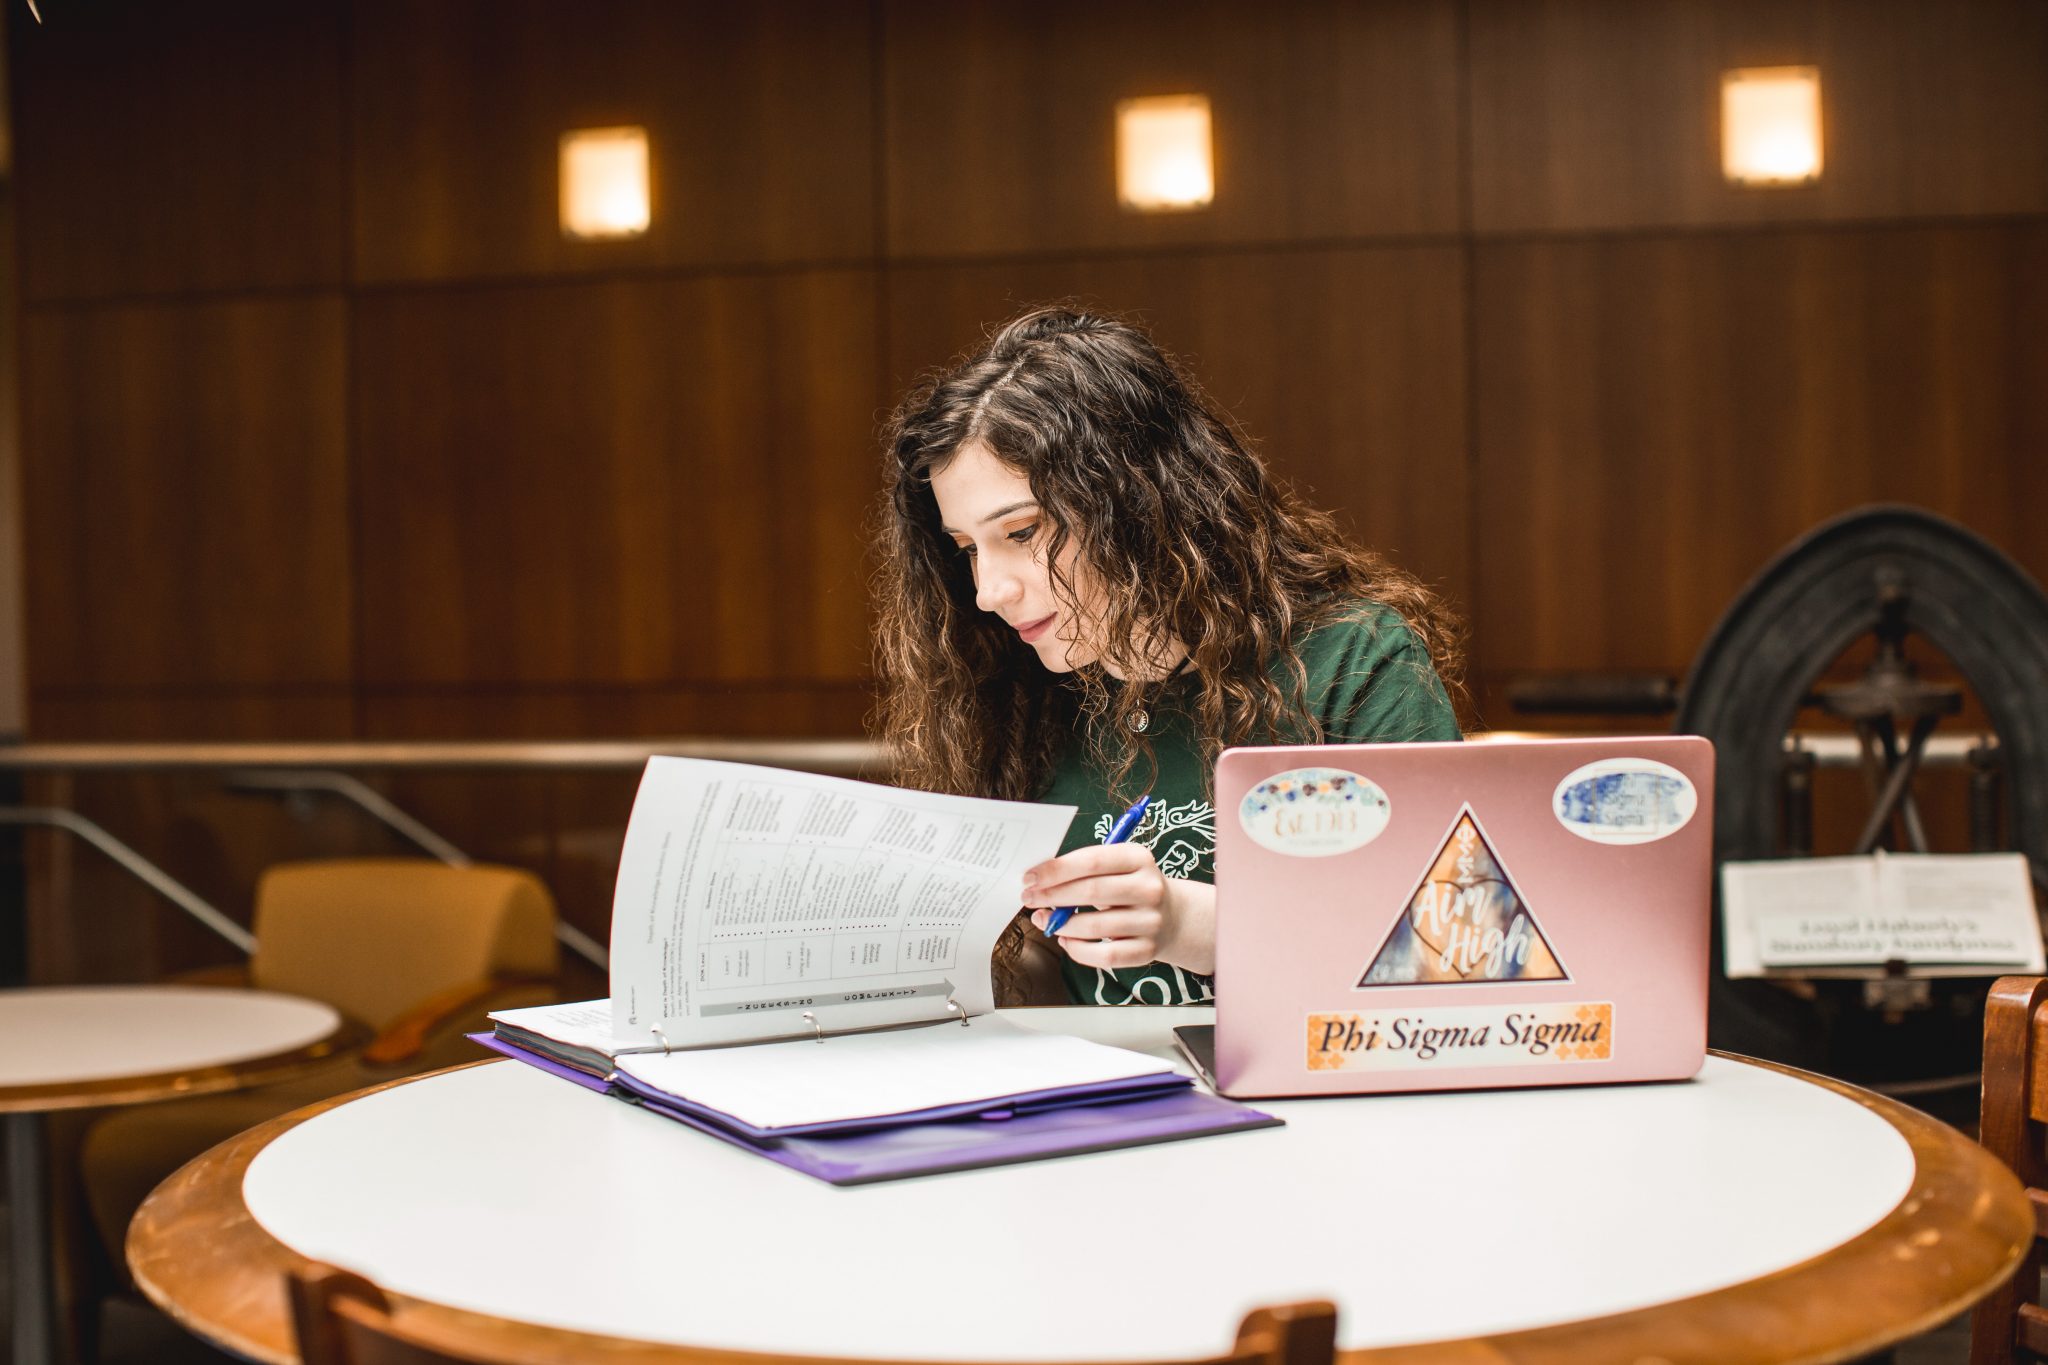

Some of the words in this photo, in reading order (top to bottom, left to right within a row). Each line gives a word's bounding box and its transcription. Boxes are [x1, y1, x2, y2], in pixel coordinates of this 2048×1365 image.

[1413, 879, 1493, 936] Aim
[1439, 914, 1529, 978] High
[737, 998, 813, 1011] INCREASING
[843, 988, 918, 1001] COMPLEXITY
[1319, 1019, 1381, 1052] Phi
[1386, 1017, 1491, 1060] Sigma
[1499, 1013, 1603, 1056] Sigma
